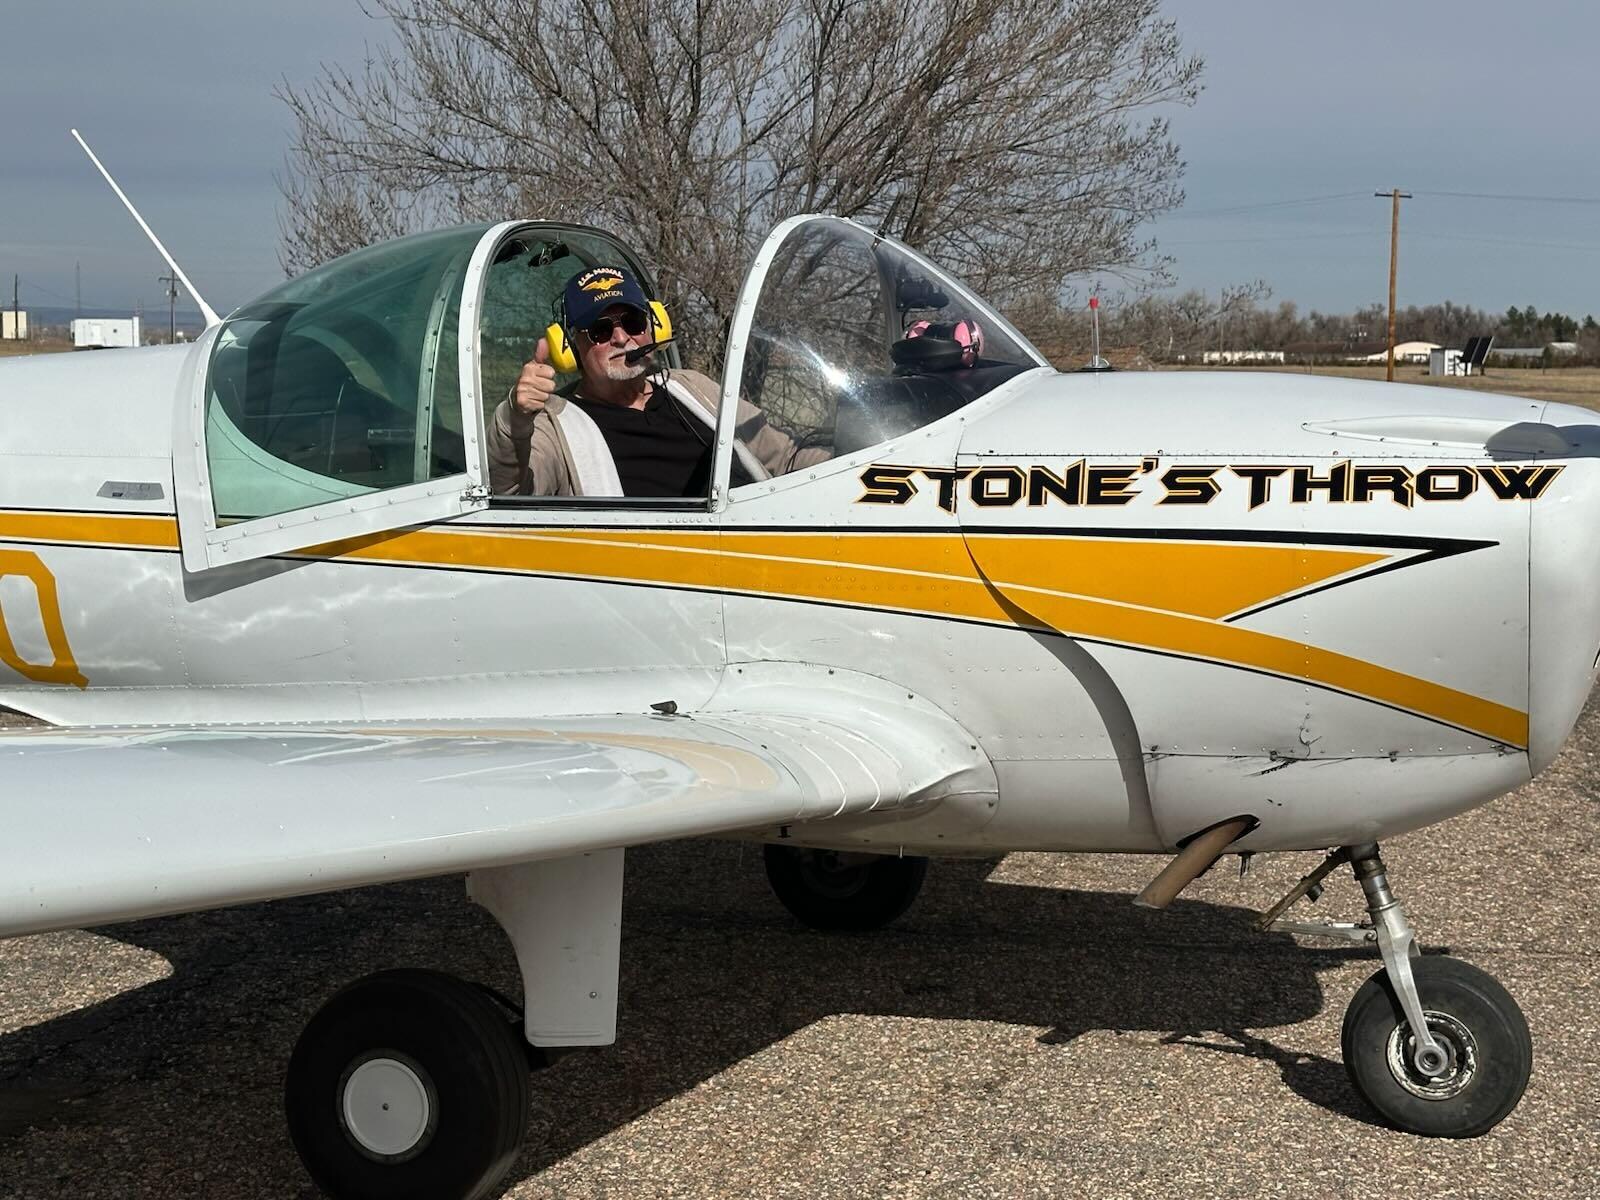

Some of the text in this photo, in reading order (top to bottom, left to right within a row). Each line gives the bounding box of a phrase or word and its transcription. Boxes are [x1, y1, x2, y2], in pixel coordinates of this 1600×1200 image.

[593, 268, 624, 278] NAVAL
[594, 290, 623, 302] AVIATION
[854, 457, 1567, 514] STONE'S THROW
